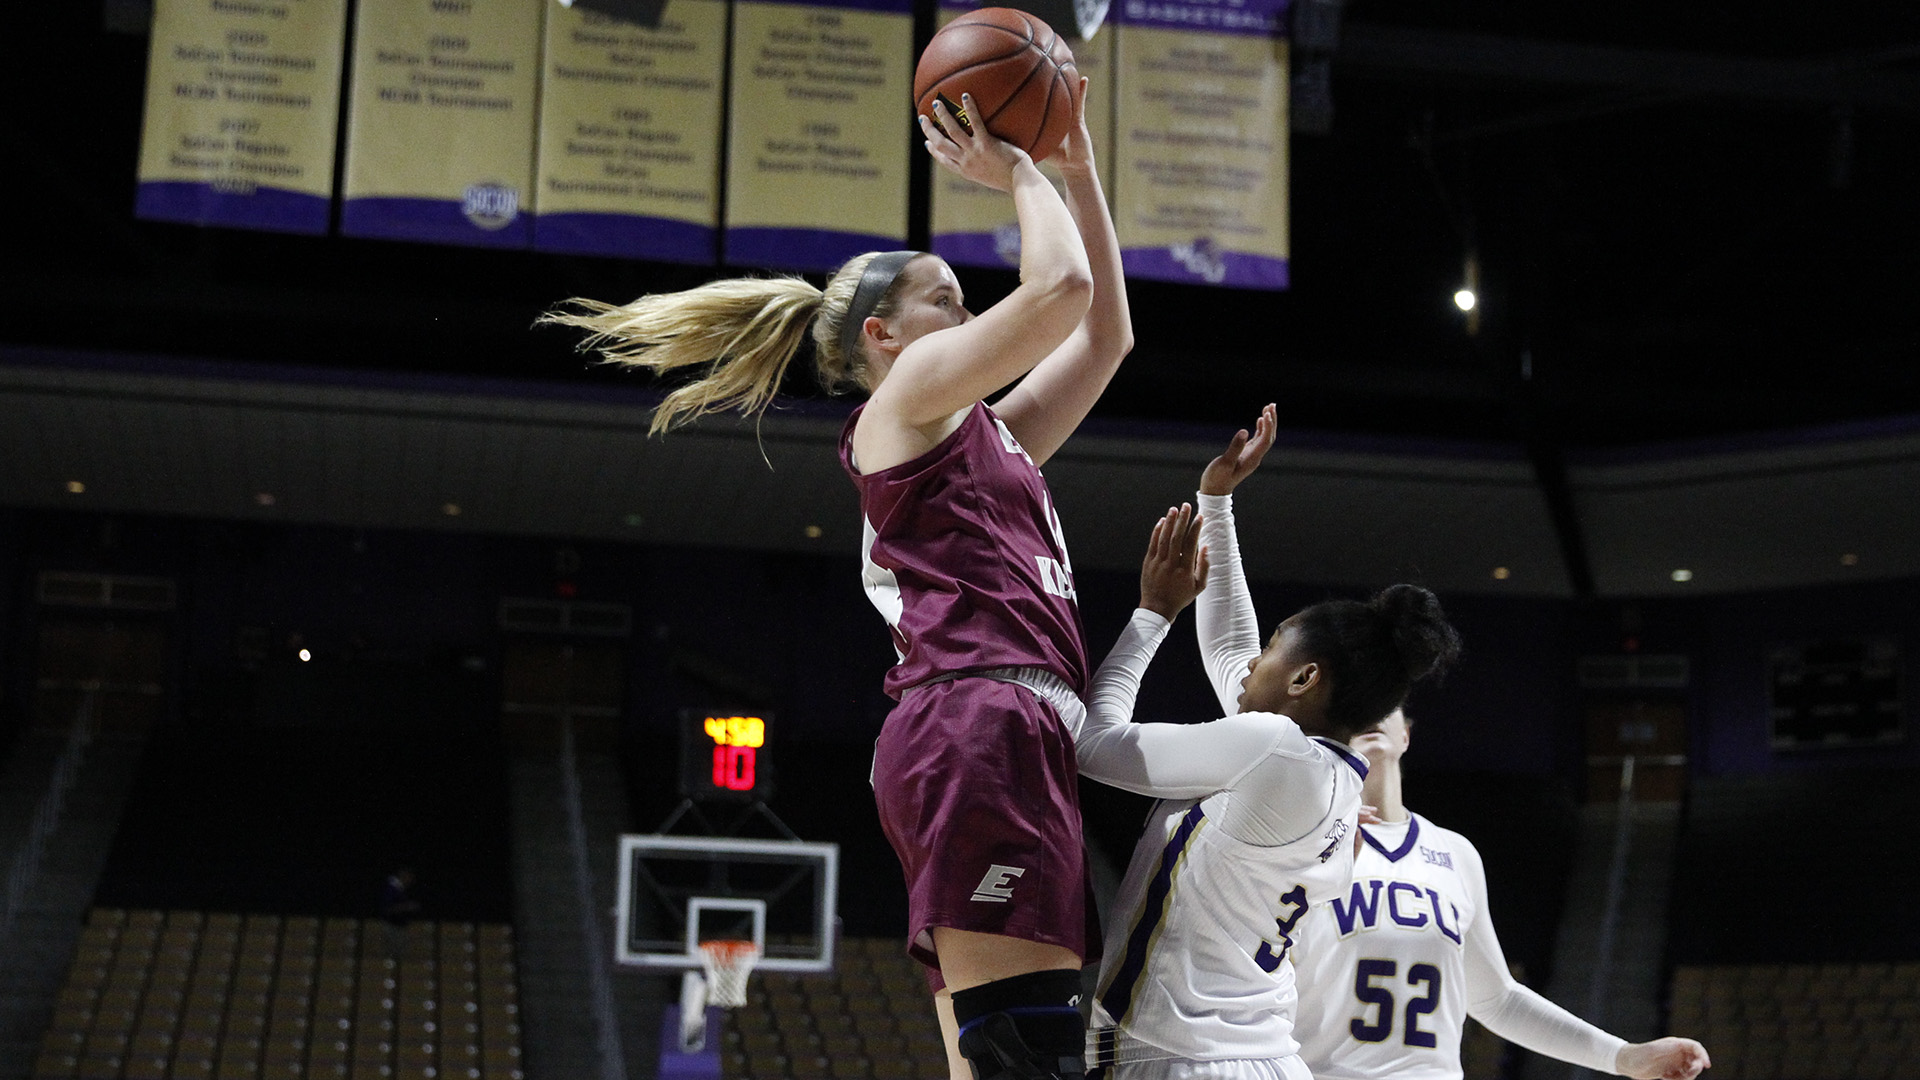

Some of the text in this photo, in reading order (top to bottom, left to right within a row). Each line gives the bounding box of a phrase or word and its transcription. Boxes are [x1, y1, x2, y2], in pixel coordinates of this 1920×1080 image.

[1126, 3, 1281, 29] BASKETBALL
[229, 50, 316, 71] Tournament
[430, 55, 515, 73] Tournament
[205, 68, 282, 87] Champion
[408, 72, 484, 91] Champion
[554, 65, 713, 92] Tournament Champion
[804, 68, 885, 87] Tournament
[173, 84, 312, 109] NCAA Tournament
[378, 88, 513, 110] NCAA Tournament
[234, 139, 290, 158] Regular
[566, 141, 694, 165] Season Champion
[169, 153, 304, 178] Season Champion
[547, 179, 709, 204] Tournament Champion
[712, 745, 756, 790] 10
[970, 864, 1025, 902] E
[1330, 880, 1461, 945] WCU
[1254, 883, 1309, 973] 3
[1350, 959, 1442, 1049] 52
